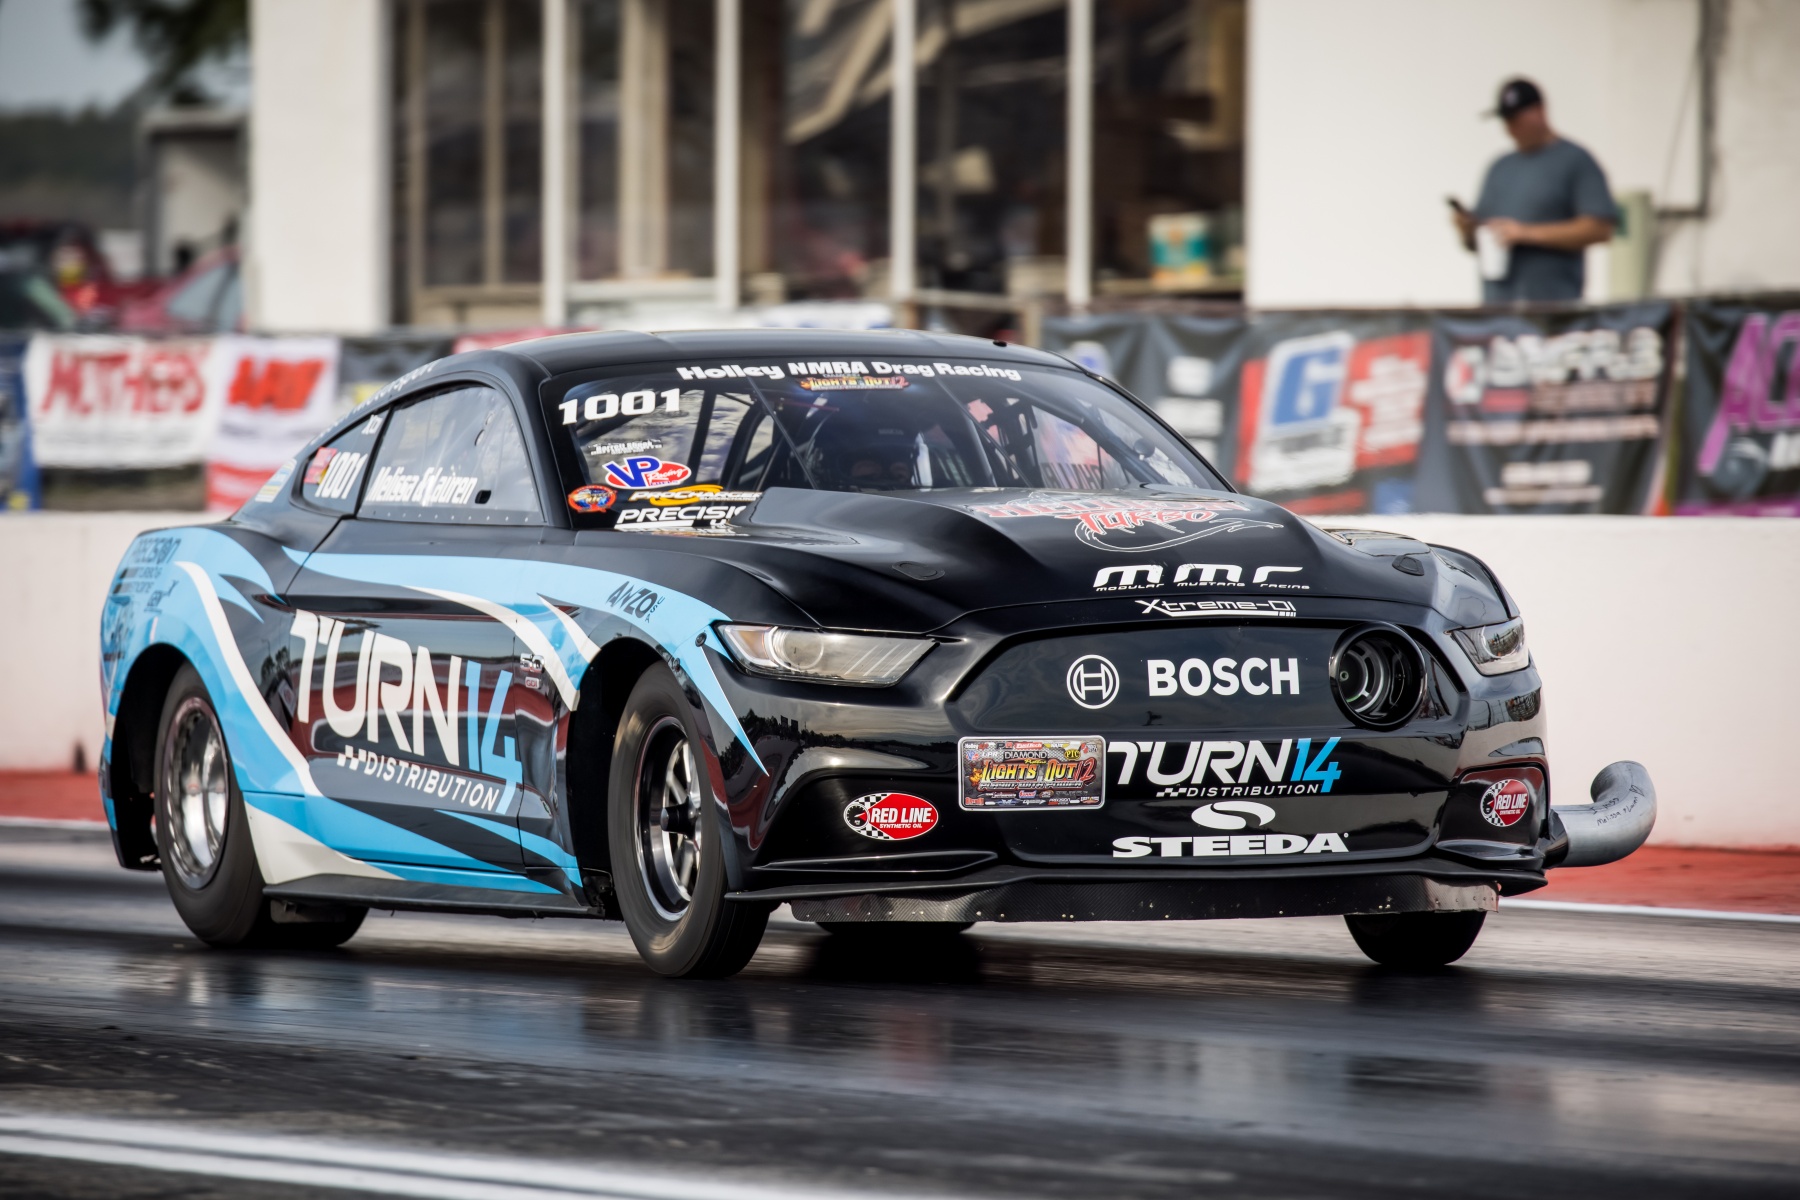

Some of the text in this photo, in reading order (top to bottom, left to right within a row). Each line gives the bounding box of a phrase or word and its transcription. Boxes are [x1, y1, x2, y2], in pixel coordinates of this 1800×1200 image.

[676, 361, 1022, 381] Holley NMRA Drag Racing
[558, 388, 681, 426] 1001
[315, 452, 368, 500] 1001
[365, 466, 420, 502] Melissa
[427, 466, 478, 504] Lauren
[603, 456, 662, 488] VP
[1055, 510, 1218, 535] TURBO
[605, 580, 658, 619] ANZO
[1147, 657, 1300, 697] BOSCH
[1004, 751, 1047, 759] DIAMOND
[364, 751, 500, 812] DISTRIBUTION
[1187, 784, 1320, 798] DISTRIBUTION
[871, 807, 933, 823] RED LINE
[1495, 793, 1528, 810] RED LINE
[1112, 833, 1349, 858] STEEDA
